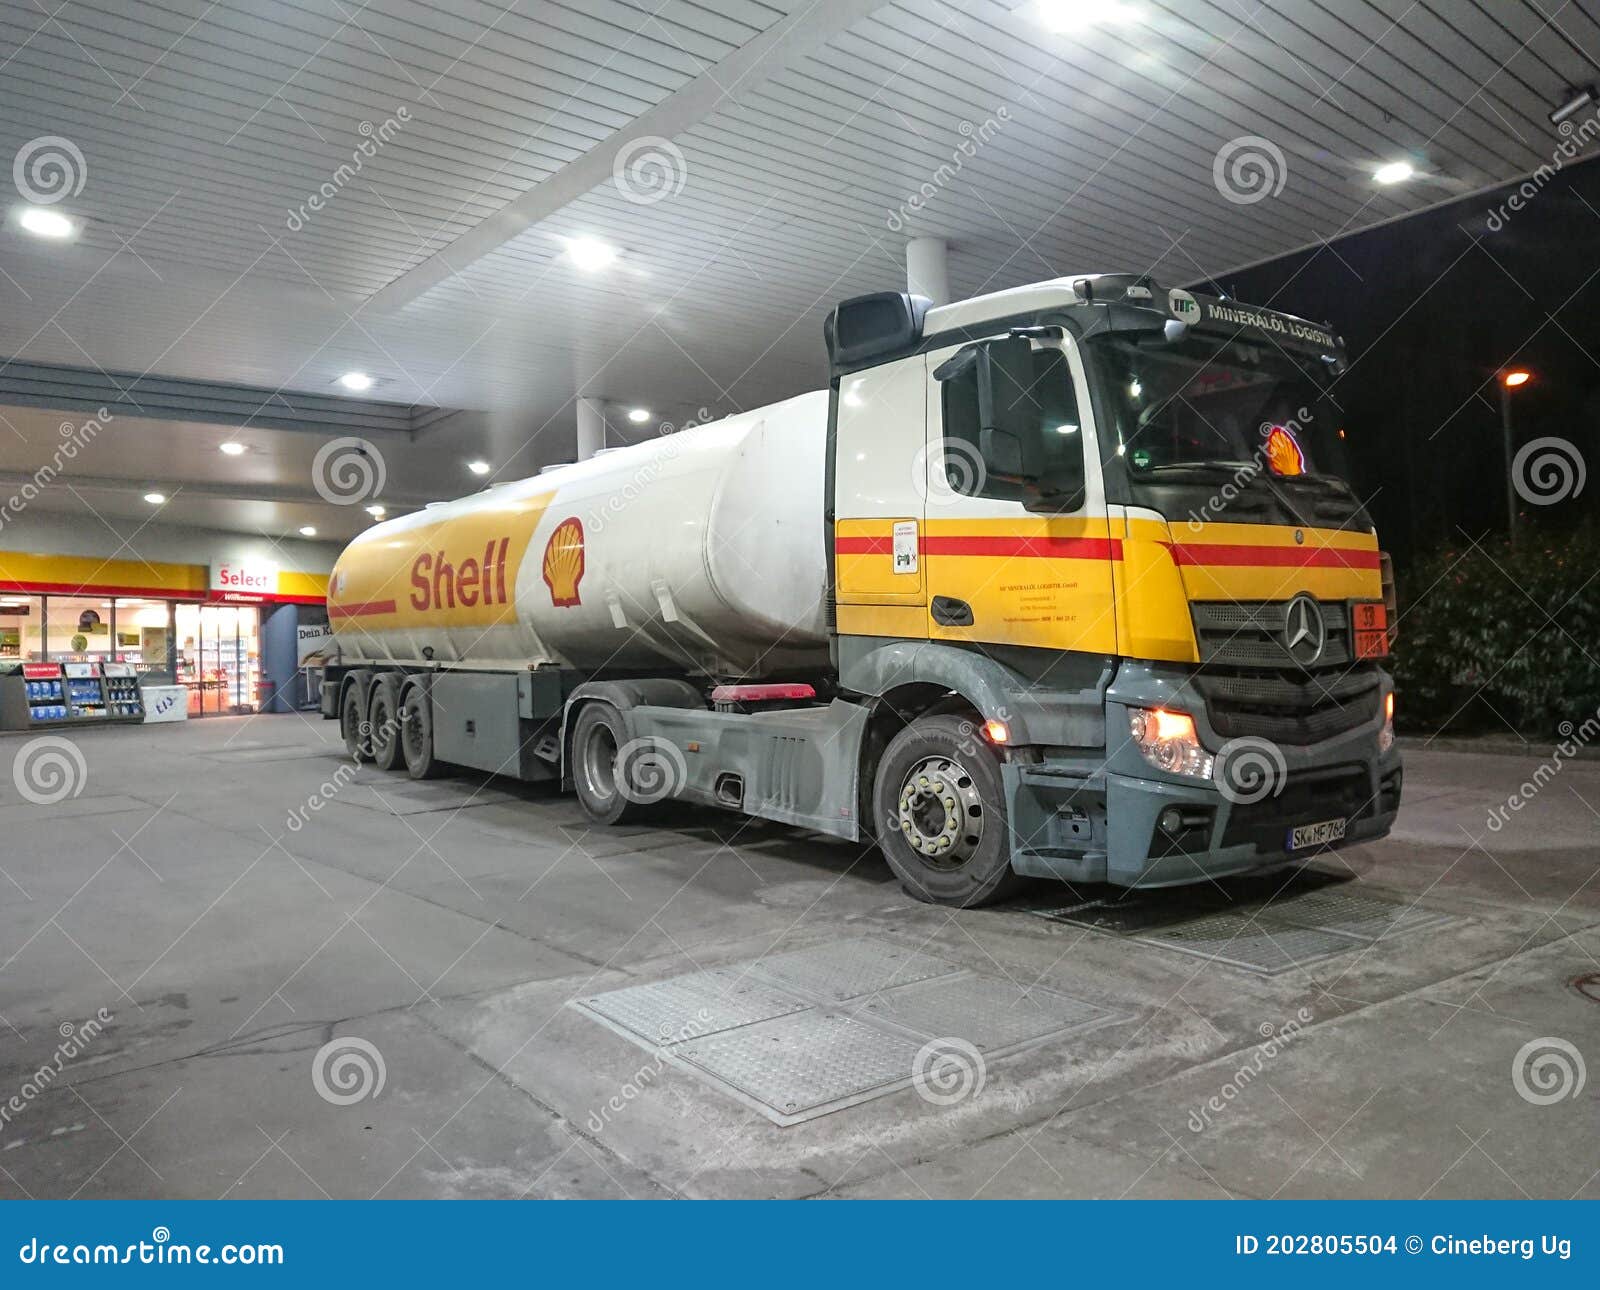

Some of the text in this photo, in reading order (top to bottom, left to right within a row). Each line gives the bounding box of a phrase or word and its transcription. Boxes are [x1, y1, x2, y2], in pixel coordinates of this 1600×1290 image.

[1208, 304, 1288, 333] MINERALÖL
[220, 569, 267, 587] Select
[410, 537, 510, 611] Shell
[299, 629, 321, 640] Dein
